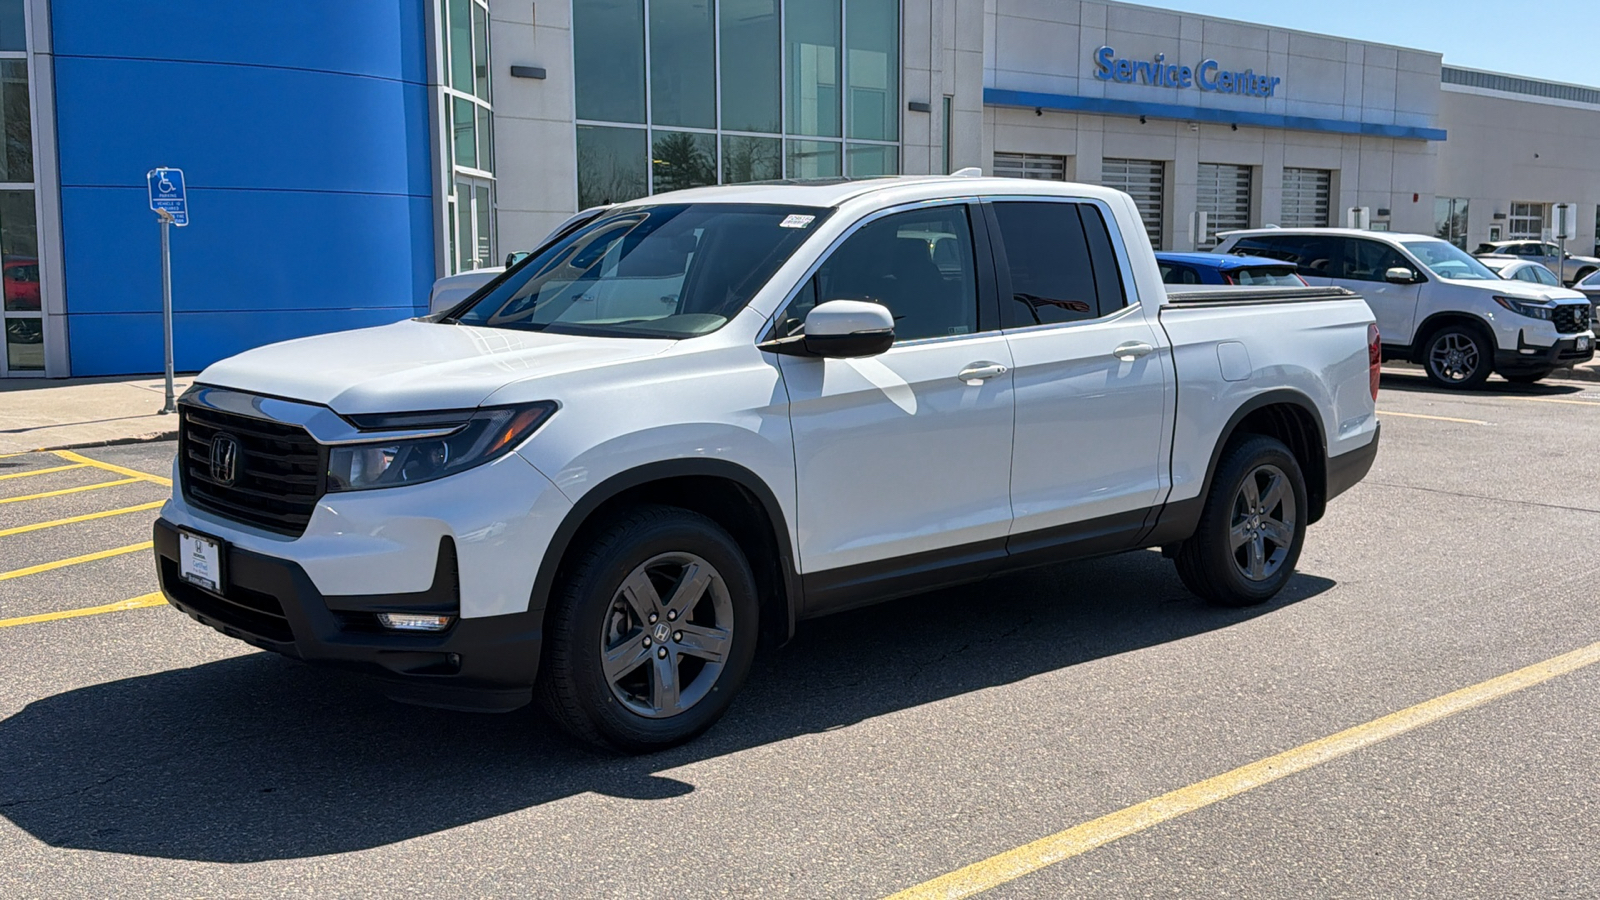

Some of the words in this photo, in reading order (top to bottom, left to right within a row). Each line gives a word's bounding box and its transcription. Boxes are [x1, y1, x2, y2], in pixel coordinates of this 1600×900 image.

[1093, 45, 1192, 88] Service
[1196, 58, 1281, 97] Center
[193, 552, 206, 560] HONDA
[193, 560, 208, 571] Certified
